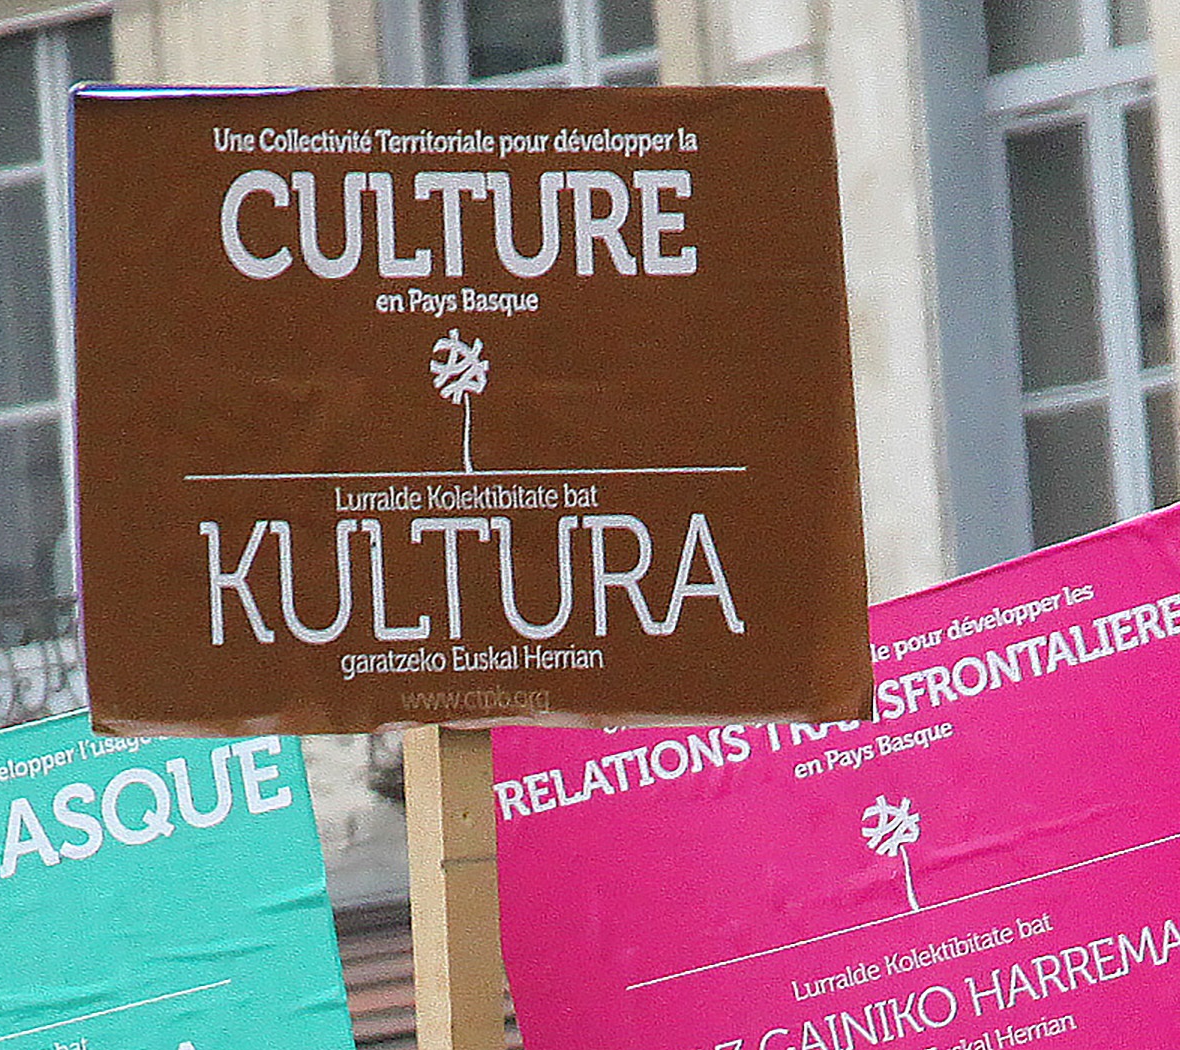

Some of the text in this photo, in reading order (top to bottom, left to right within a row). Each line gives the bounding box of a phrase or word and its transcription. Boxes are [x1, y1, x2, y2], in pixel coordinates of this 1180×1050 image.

[213, 127, 698, 159] Une Collectivité Territoriale pour développer la
[221, 169, 697, 279] CULTURE
[375, 288, 539, 318] en Pays Basque
[335, 483, 599, 512] Lurralde Kolektibitate bat
[199, 513, 745, 646] KULTURA
[892, 628, 943, 661] pour
[947, 593, 1062, 641] développer
[1062, 584, 1094, 606] les
[341, 644, 604, 681] garatzeko Euskal Herrian
[492, 724, 751, 821] RELATIONS
[794, 722, 953, 779] en Pays Basque
[791, 912, 1054, 1002] Lurralde Kolektibitate bat
[994, 1015, 1078, 1050] Herrian
